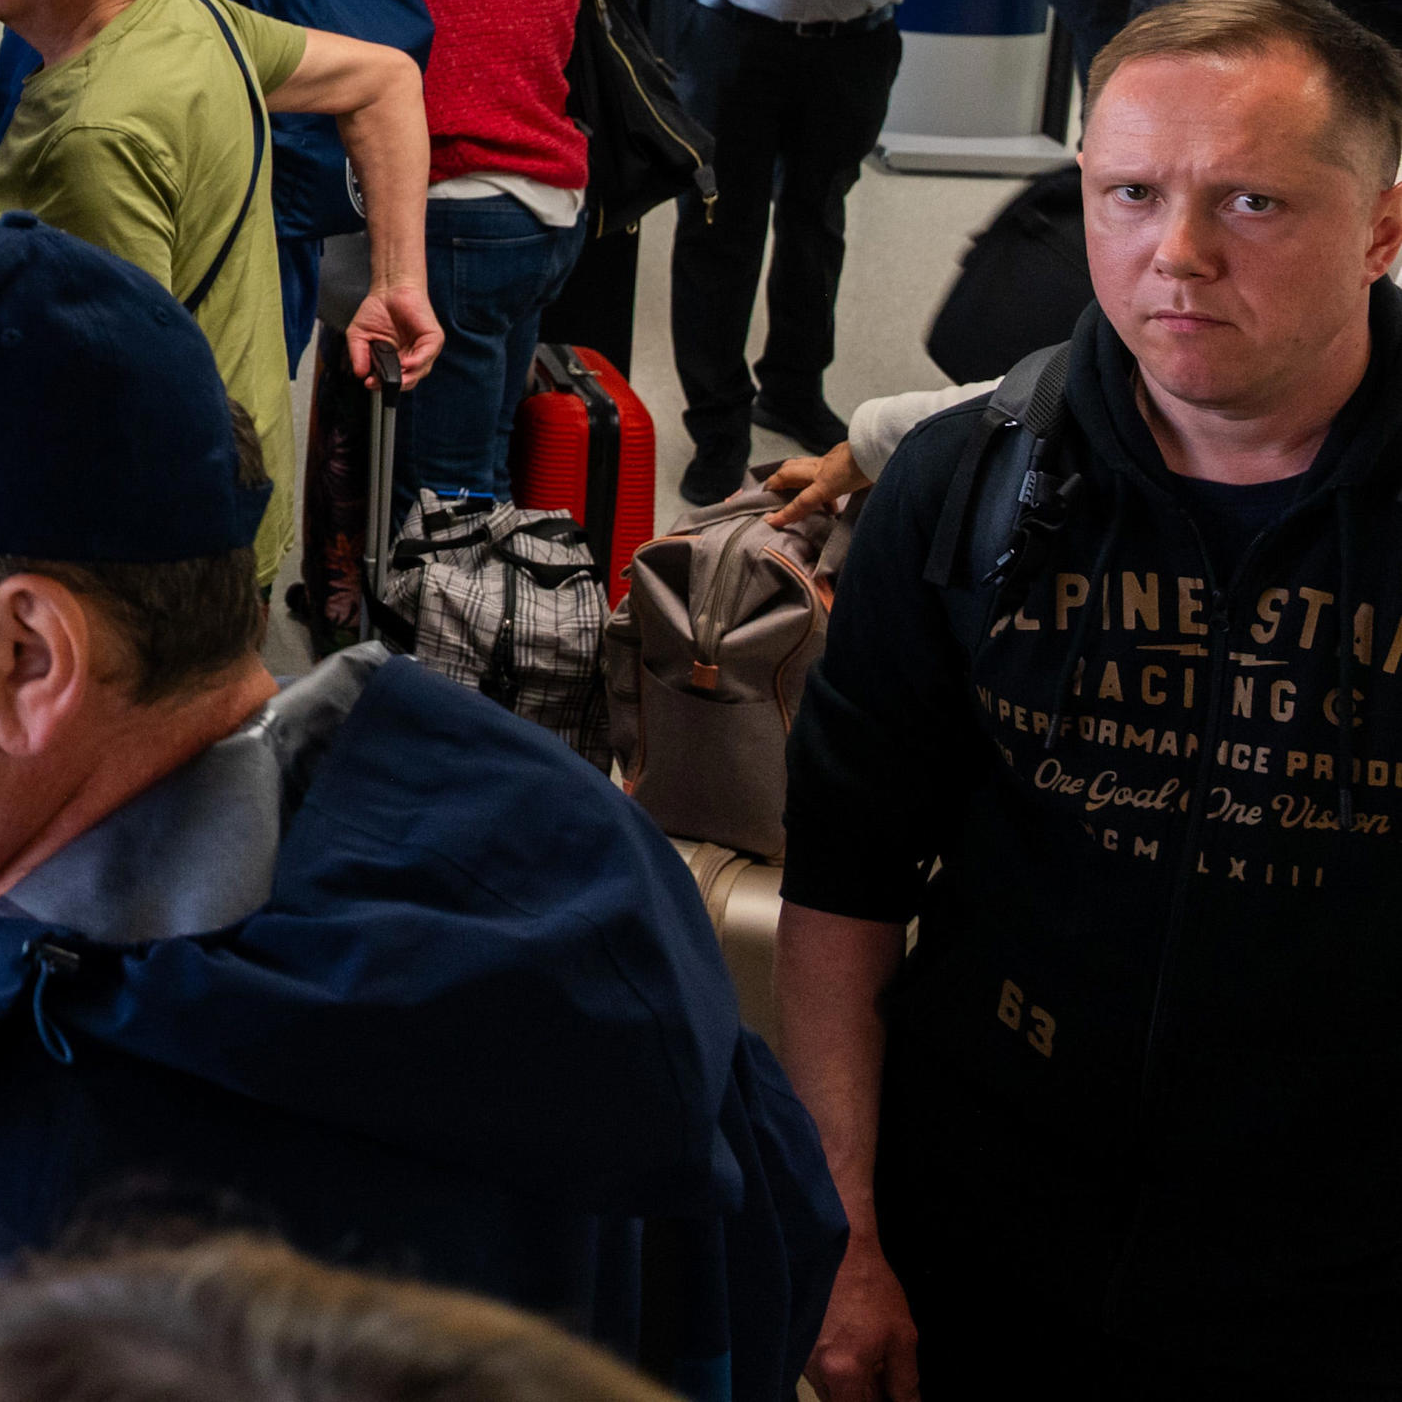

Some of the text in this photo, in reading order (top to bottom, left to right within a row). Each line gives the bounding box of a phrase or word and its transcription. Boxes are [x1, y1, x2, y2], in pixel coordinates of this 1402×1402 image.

[1071, 656, 1298, 724] ACING
[1034, 757, 1086, 796] One
[997, 978, 1057, 1059] 63
